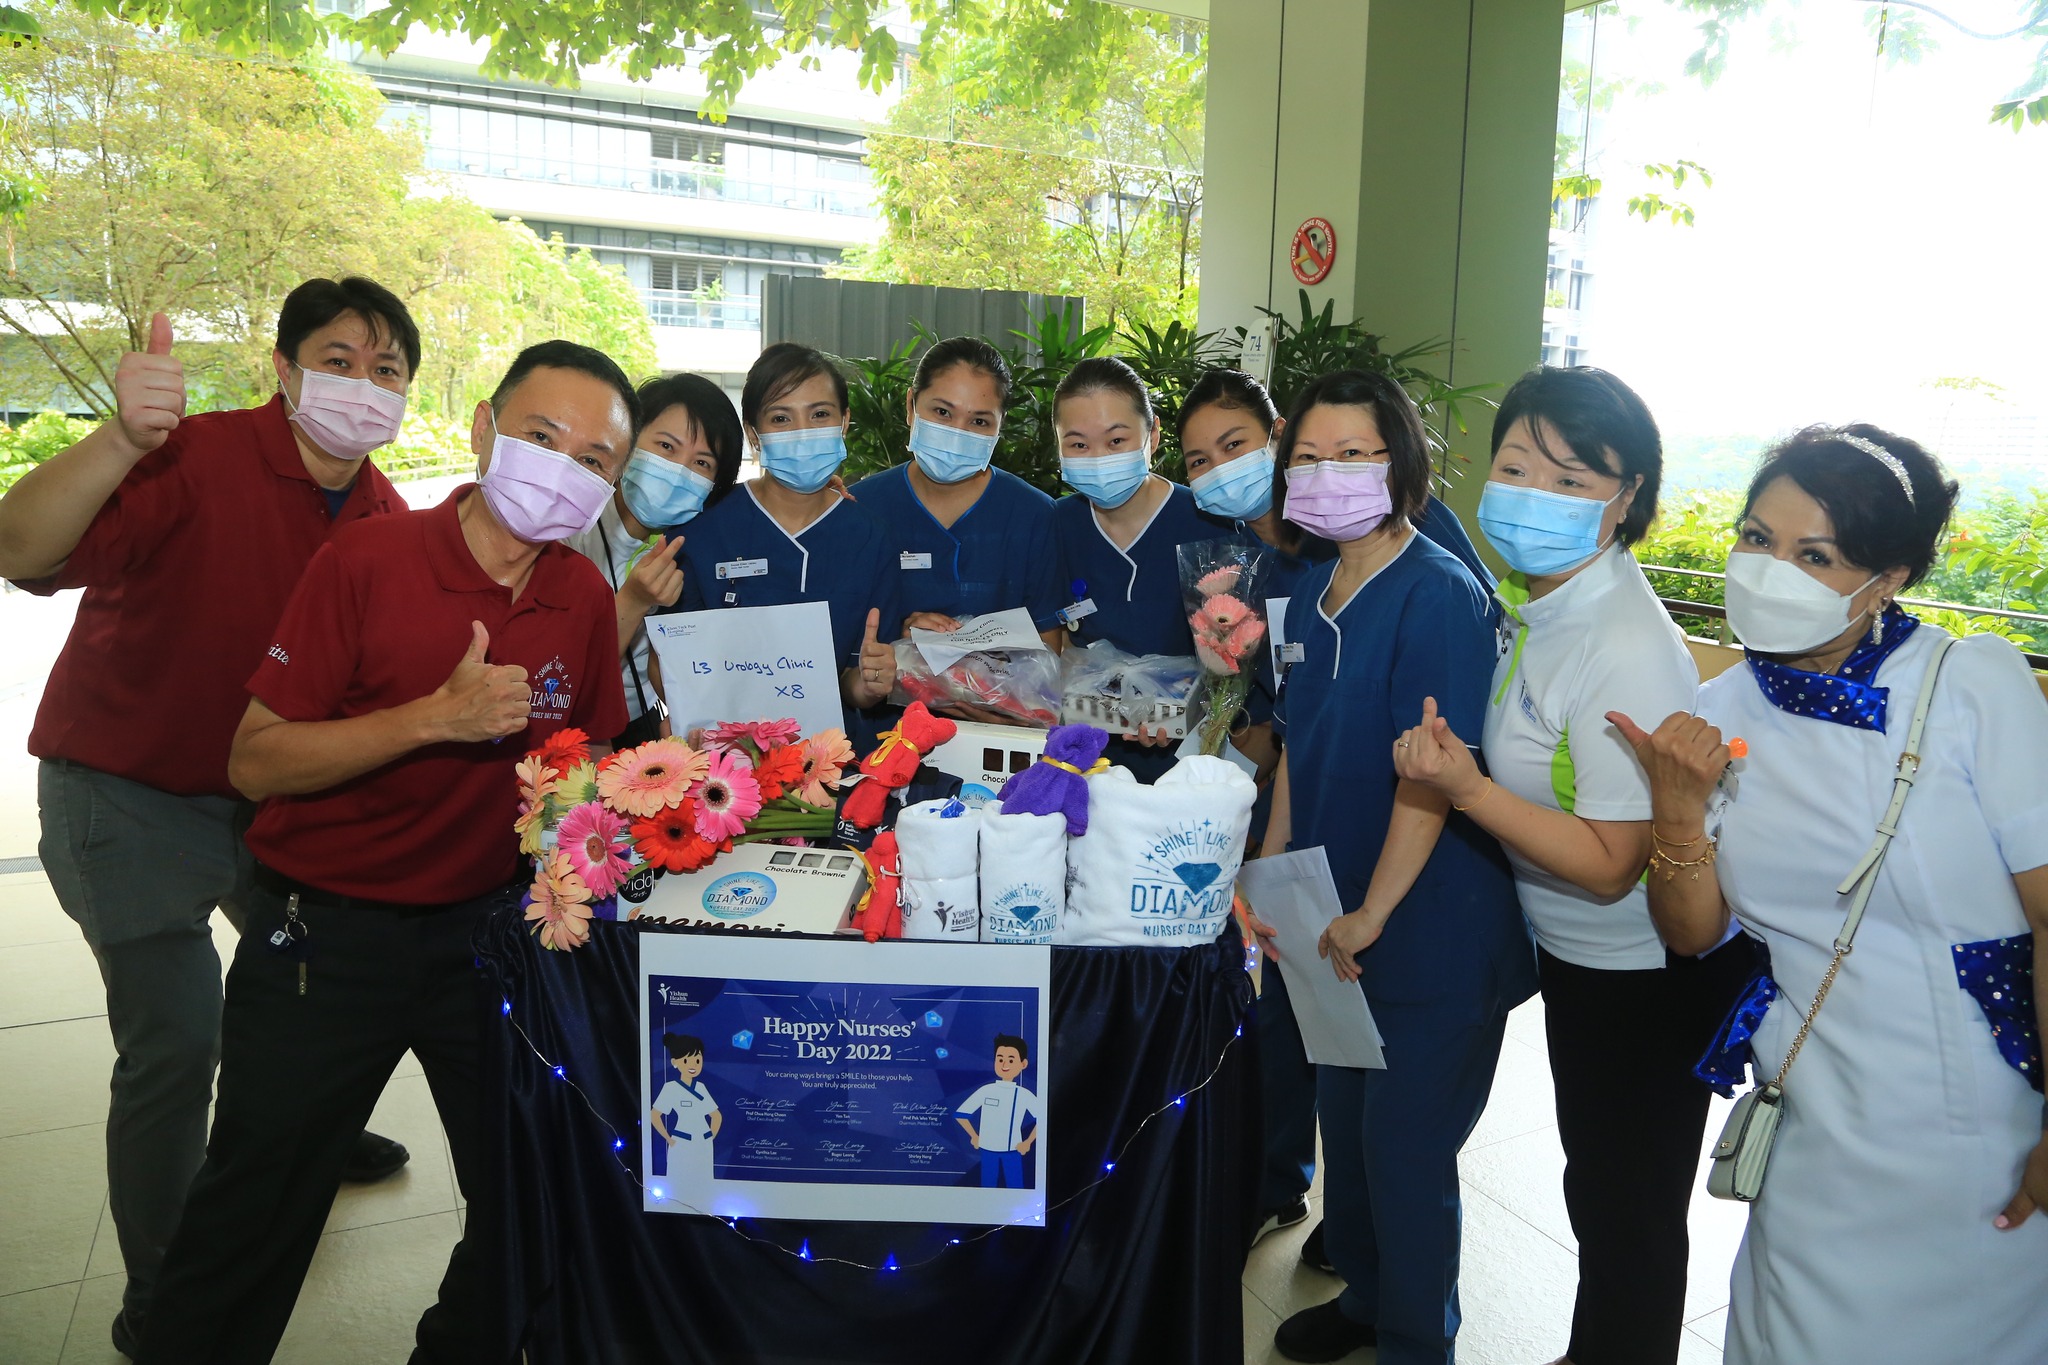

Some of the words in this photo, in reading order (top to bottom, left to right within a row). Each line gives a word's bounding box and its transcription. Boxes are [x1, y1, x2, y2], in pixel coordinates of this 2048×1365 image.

[1249, 335, 1262, 352] 74
[538, 661, 553, 678] SHINE
[555, 661, 565, 673] LIKE
[692, 660, 712, 674] L3
[724, 660, 774, 676] Urology
[776, 656, 814, 670] Clinic
[1154, 831, 1195, 858] SHINE
[1206, 831, 1232, 851] LIKE
[764, 865, 808, 875] Chocolate
[811, 869, 847, 879] Brownie
[706, 893, 769, 906] DIAMOND
[999, 888, 1021, 906] SHINE
[1026, 888, 1044, 899] LIKE
[951, 915, 975, 926] Health
[989, 913, 1057, 936] DIAMOND
[1187, 922, 1208, 936] DAY
[763, 1016, 835, 1041] Happy
[837, 1018, 917, 1038] Nurses'
[796, 1041, 842, 1065] Day
[844, 1043, 892, 1061] 2022
[765, 1070, 779, 1078] Your
[779, 1071, 799, 1080] caring
[815, 1072, 836, 1080] brings
[840, 1072, 860, 1080] SMILE
[867, 1073, 885, 1081] those
[885, 1074, 898, 1082] you
[898, 1074, 914, 1083] help.
[824, 1081, 839, 1090] truly
[839, 1082, 877, 1090] appreciated.
